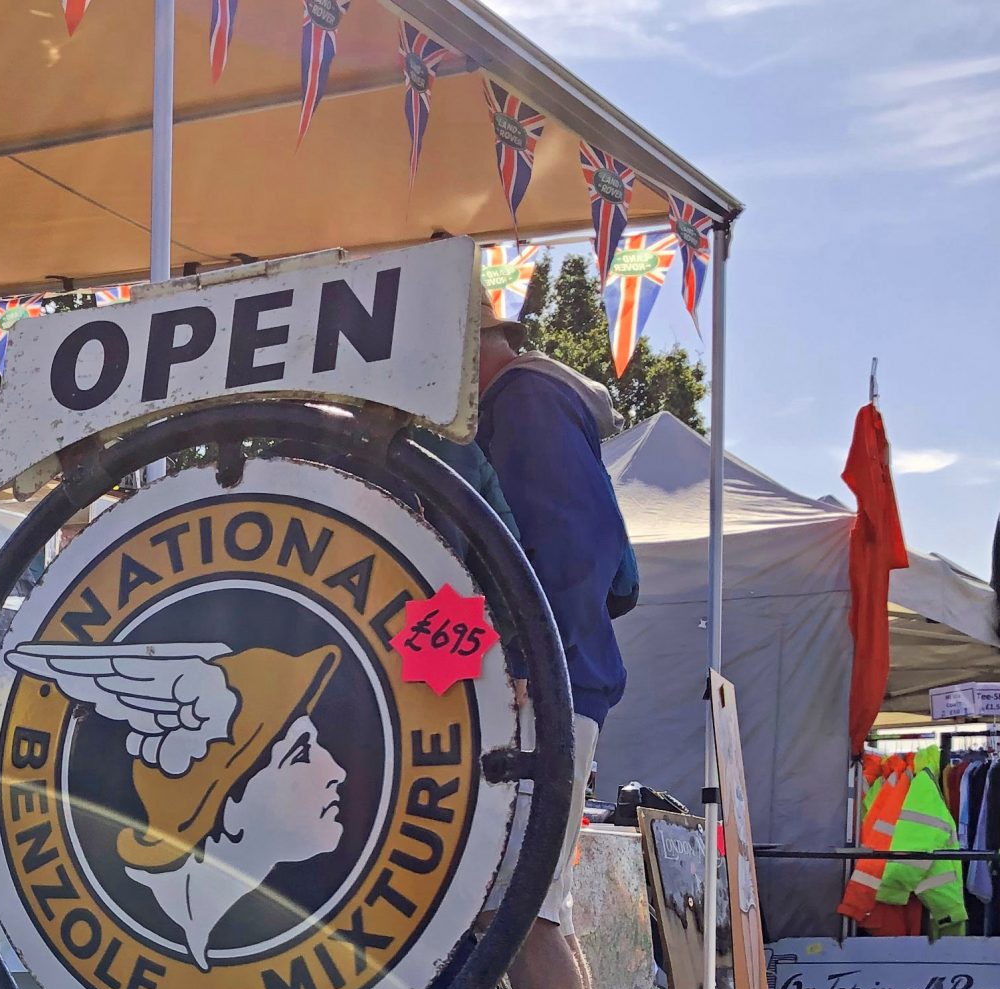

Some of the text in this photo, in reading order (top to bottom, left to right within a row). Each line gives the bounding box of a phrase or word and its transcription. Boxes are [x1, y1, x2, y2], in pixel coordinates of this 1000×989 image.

[310, 4, 336, 26] ROVER
[497, 117, 519, 134] LAND
[499, 129, 523, 147] ROVER
[600, 172, 620, 189] LAND
[600, 183, 623, 199] ROVER
[49, 266, 401, 412] OPEN
[60, 511, 413, 652] NATIONAL
[404, 609, 486, 656] £695
[977, 692, 1000, 700] Tee-S
[659, 830, 696, 860] LONDON
